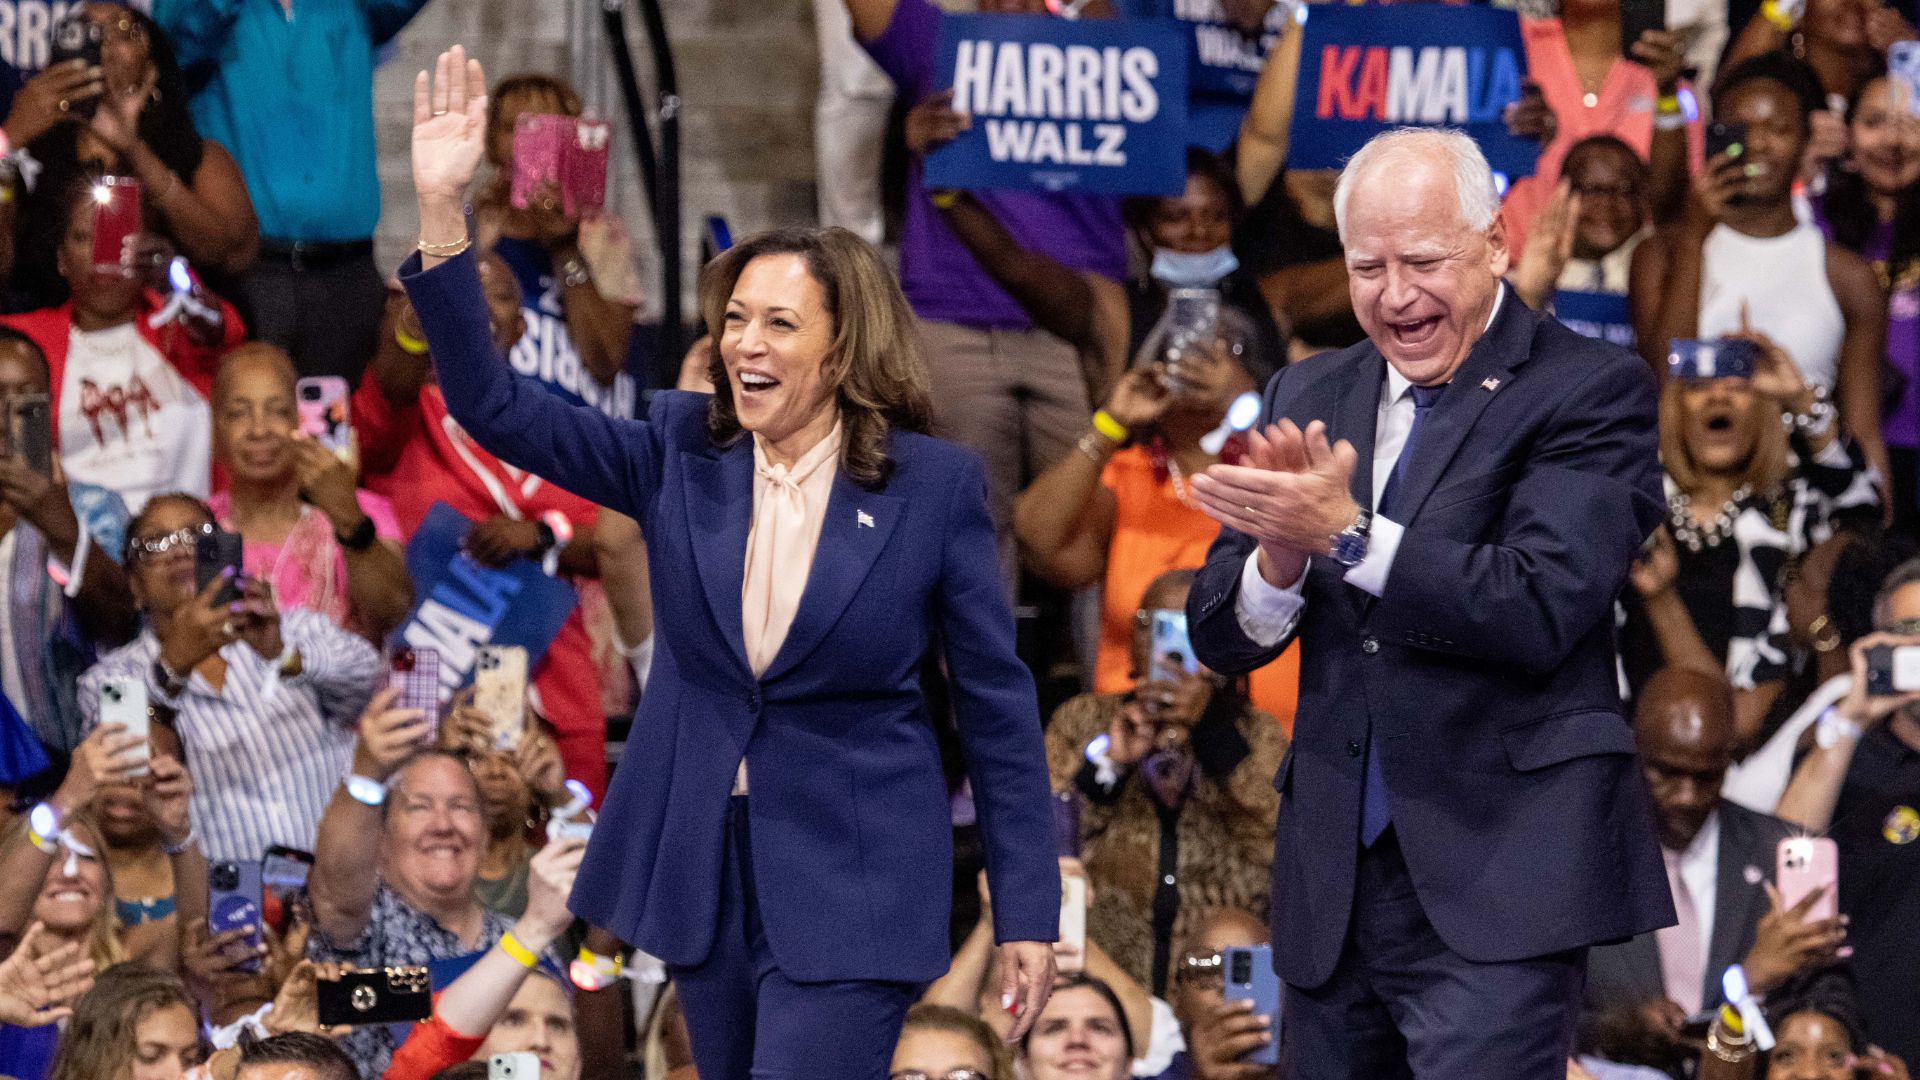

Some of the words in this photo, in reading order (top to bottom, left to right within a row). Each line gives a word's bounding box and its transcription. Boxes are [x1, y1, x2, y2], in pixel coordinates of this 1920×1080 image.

[953, 40, 1160, 123] HARRIS
[1316, 44, 1522, 123] KAMALA
[984, 119, 1128, 167] WALZ
